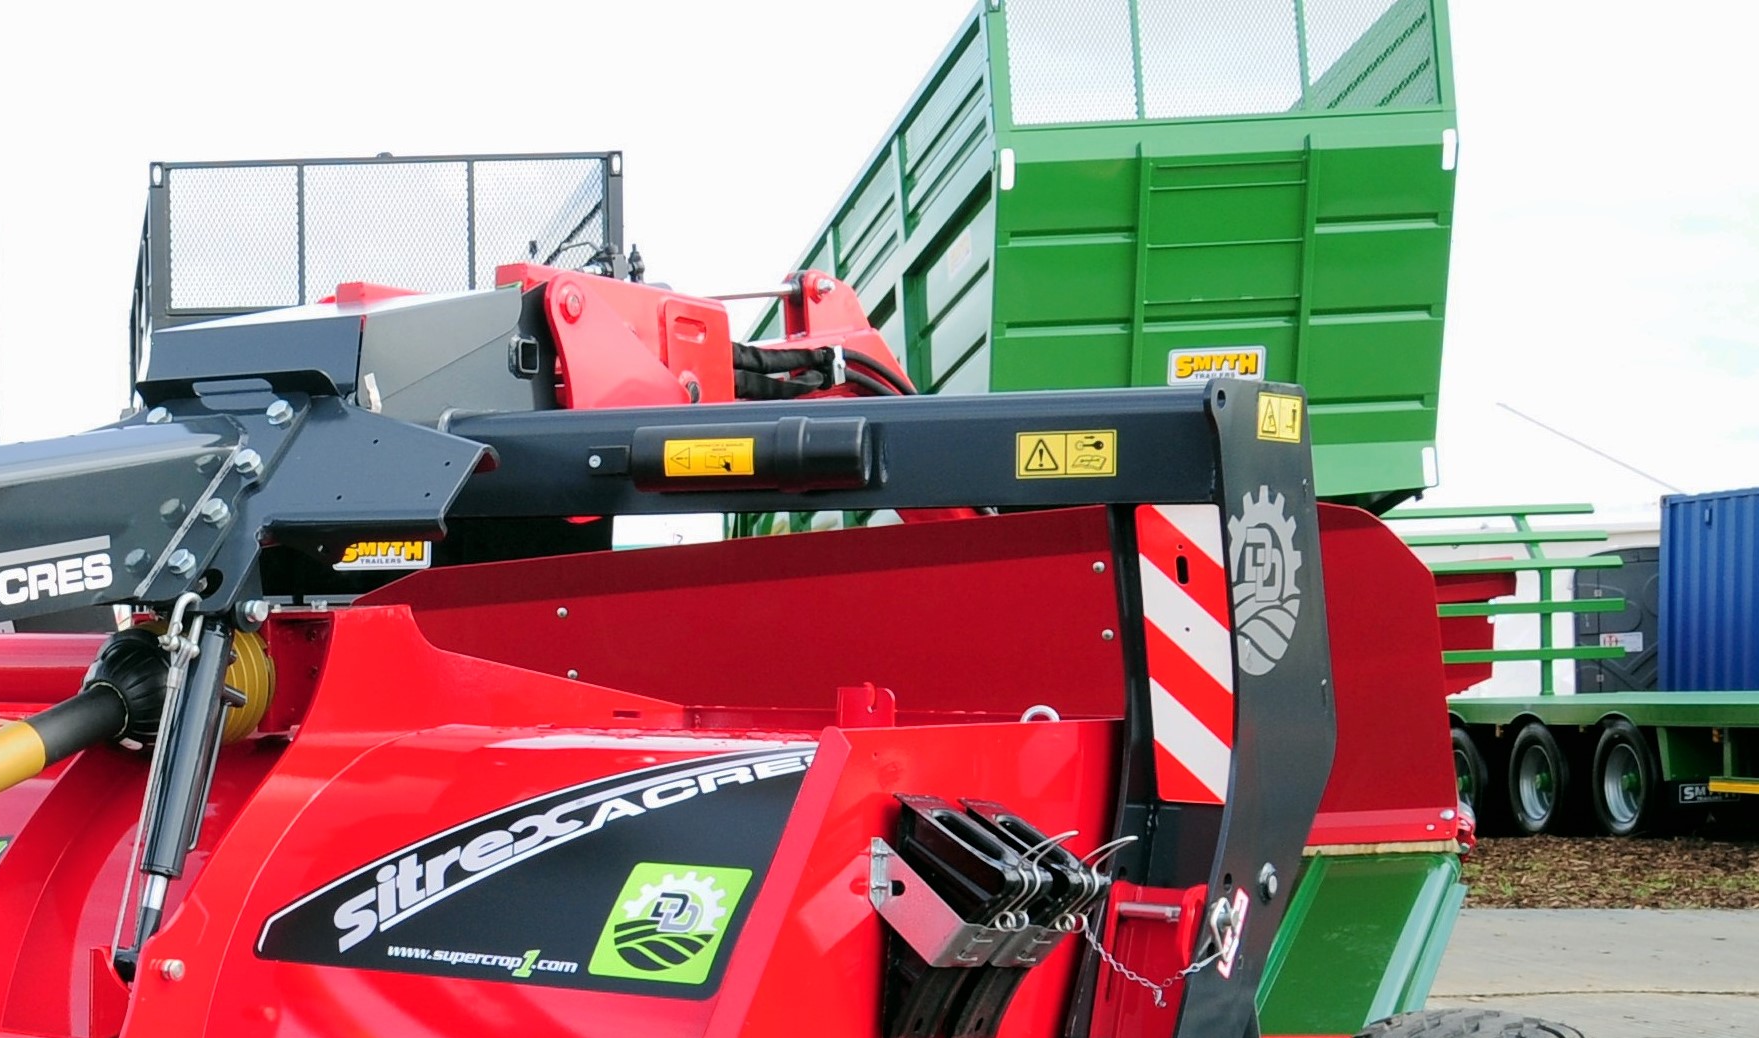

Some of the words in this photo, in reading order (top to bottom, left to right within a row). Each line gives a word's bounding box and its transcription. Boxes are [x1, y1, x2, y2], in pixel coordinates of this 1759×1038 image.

[1175, 352, 1258, 379] SMYTH
[342, 541, 424, 563] SMYTH
[333, 798, 586, 953] sitrex
[589, 754, 816, 829] ACRE
[387, 945, 579, 978] www.supercrop1.com
